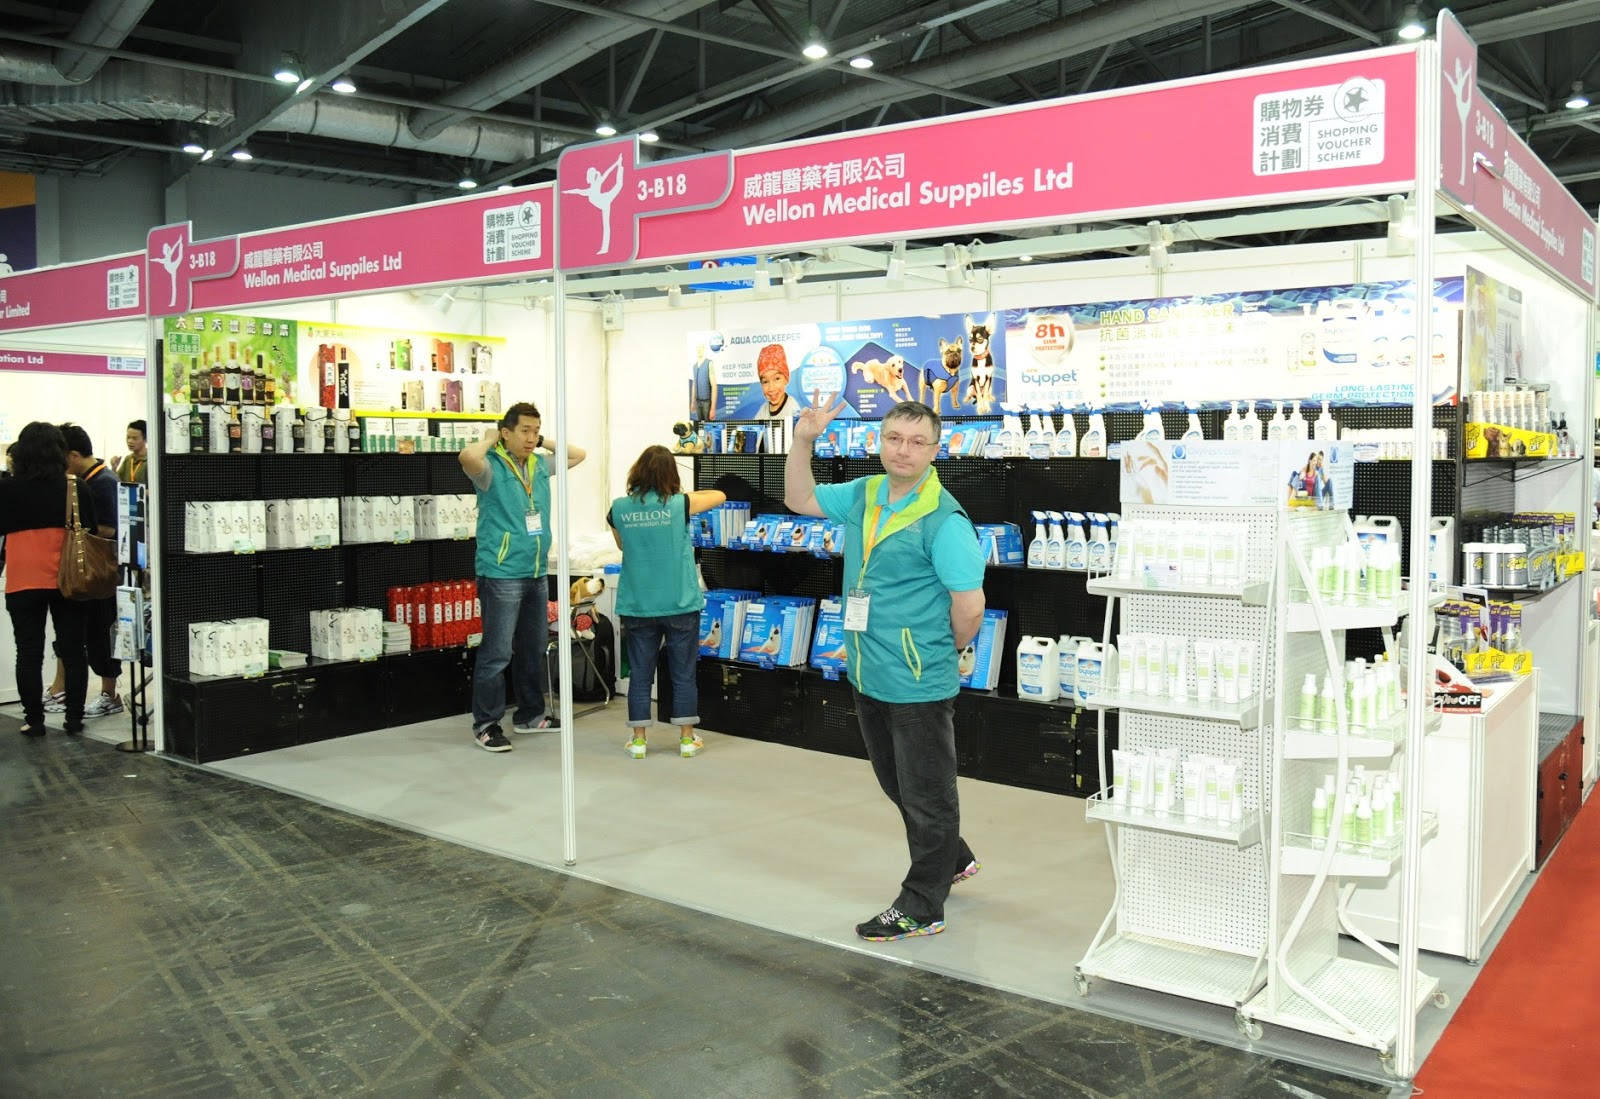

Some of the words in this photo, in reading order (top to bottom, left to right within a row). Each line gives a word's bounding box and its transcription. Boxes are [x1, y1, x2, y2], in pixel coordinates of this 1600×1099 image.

[1260, 95, 1324, 122] 購物券
[1260, 122, 1302, 147] 消費
[1317, 124, 1379, 139] SHOPPING
[1317, 137, 1372, 151] VOUCHER
[1259, 147, 1302, 173] 計劃
[1317, 150, 1361, 163] SCHEME
[743, 152, 905, 199] 威龍醫藥有限公司
[636, 173, 687, 202] 3-B18
[742, 199, 815, 226] Wellon
[822, 182, 911, 217] Medical
[919, 171, 1024, 209] Suppiles
[1034, 162, 1073, 192] Ltd
[486, 211, 514, 229] 購物券
[486, 230, 505, 245] 消費
[511, 232, 538, 241] SHOPPING
[511, 240, 536, 249] VOUCHER
[189, 251, 216, 270] 3-B18
[244, 241, 323, 270] 威龍醫藥有限公司
[486, 246, 505, 262] 計劃
[511, 249, 531, 257] SCHEME
[243, 271, 280, 289] Wellon
[283, 261, 326, 284] Medical
[330, 256, 379, 281] Suppiles
[383, 251, 402, 271] Ltd
[5, 302, 30, 318] Limited
[1101, 310, 1144, 324] HAND
[1035, 323, 1066, 338] 8h
[730, 336, 751, 345] AQUA
[752, 332, 801, 343] COOLKEEPER
[27, 355, 44, 364] Ltd
[738, 362, 753, 370] YOUR
[722, 371, 737, 379] BODY
[1021, 369, 1077, 386] byopet
[1311, 392, 1343, 400] GERM
[621, 509, 672, 522] WELLON
